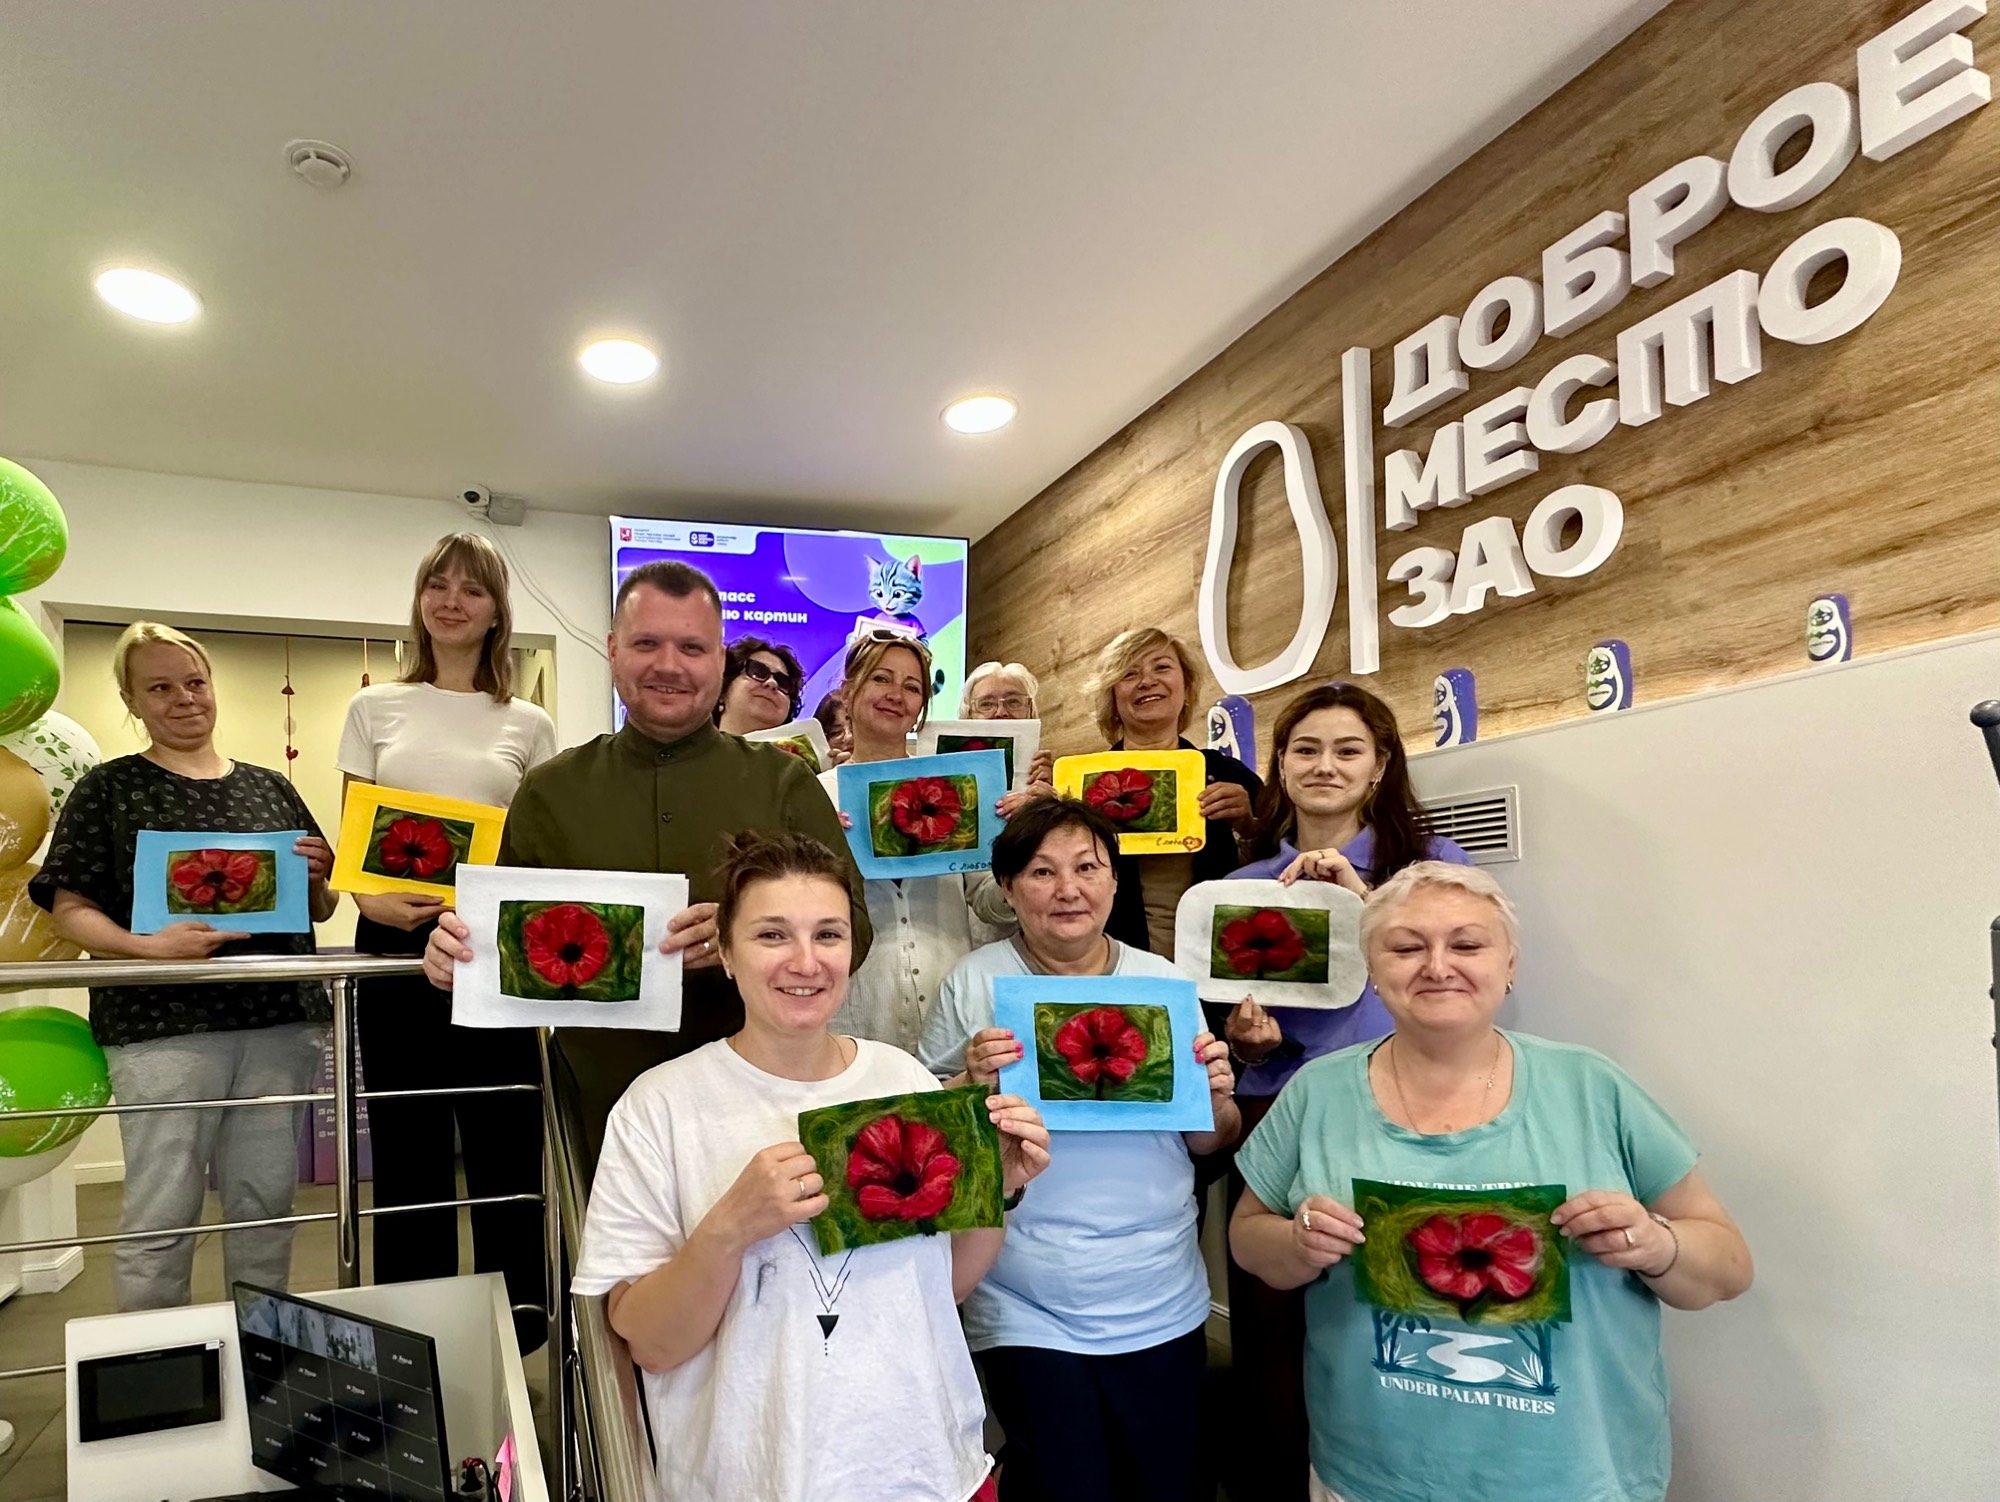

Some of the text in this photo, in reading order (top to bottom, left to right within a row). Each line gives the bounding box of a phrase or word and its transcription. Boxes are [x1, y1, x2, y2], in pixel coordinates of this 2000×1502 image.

[1383, 0, 1991, 427] ДОБРОЕ
[1387, 484, 1624, 628] ЗАО
[718, 591, 756, 603] ласс
[743, 610, 808, 625] картин
[1379, 1376, 1556, 1415] UNDER PALM TREES
